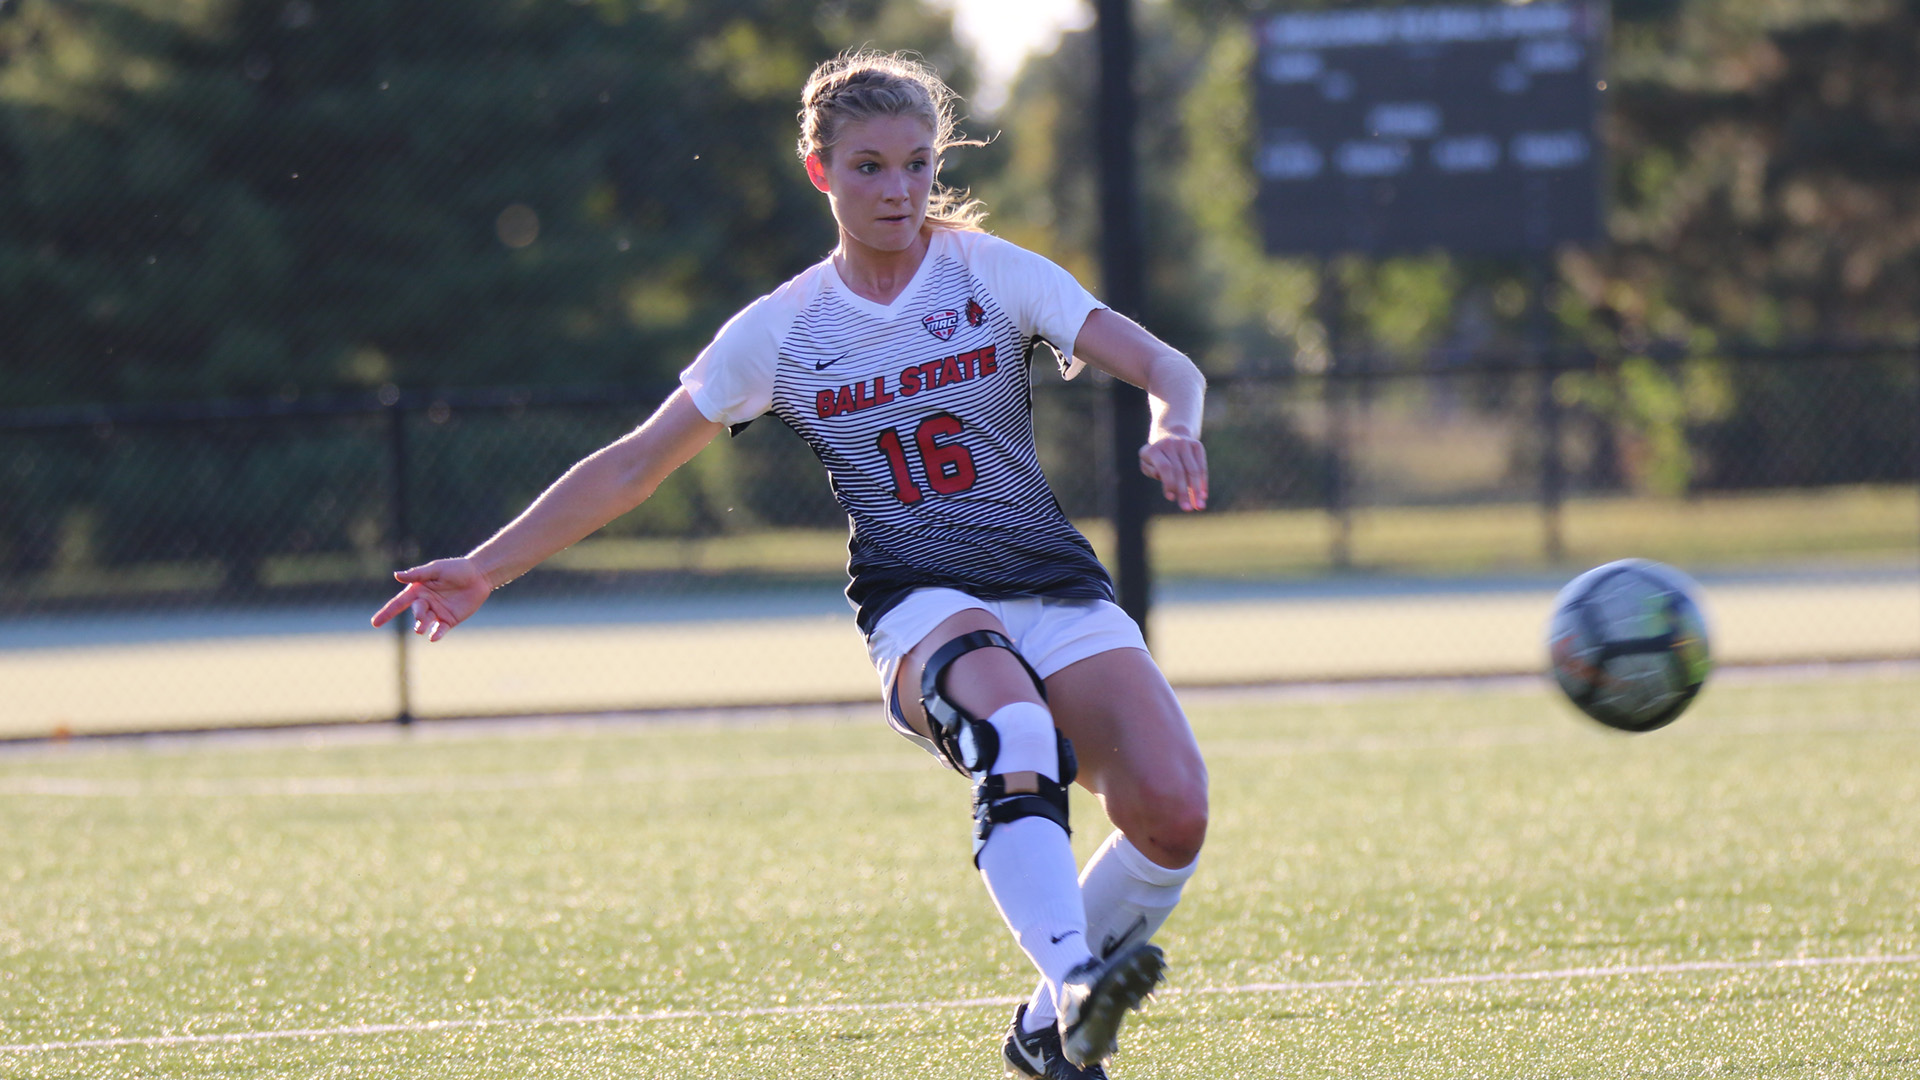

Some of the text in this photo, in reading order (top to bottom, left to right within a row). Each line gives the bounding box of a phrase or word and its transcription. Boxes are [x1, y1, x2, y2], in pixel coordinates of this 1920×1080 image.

[927, 316, 958, 332] MAC
[816, 343, 998, 419] BALL STATE
[875, 411, 978, 505] 16
